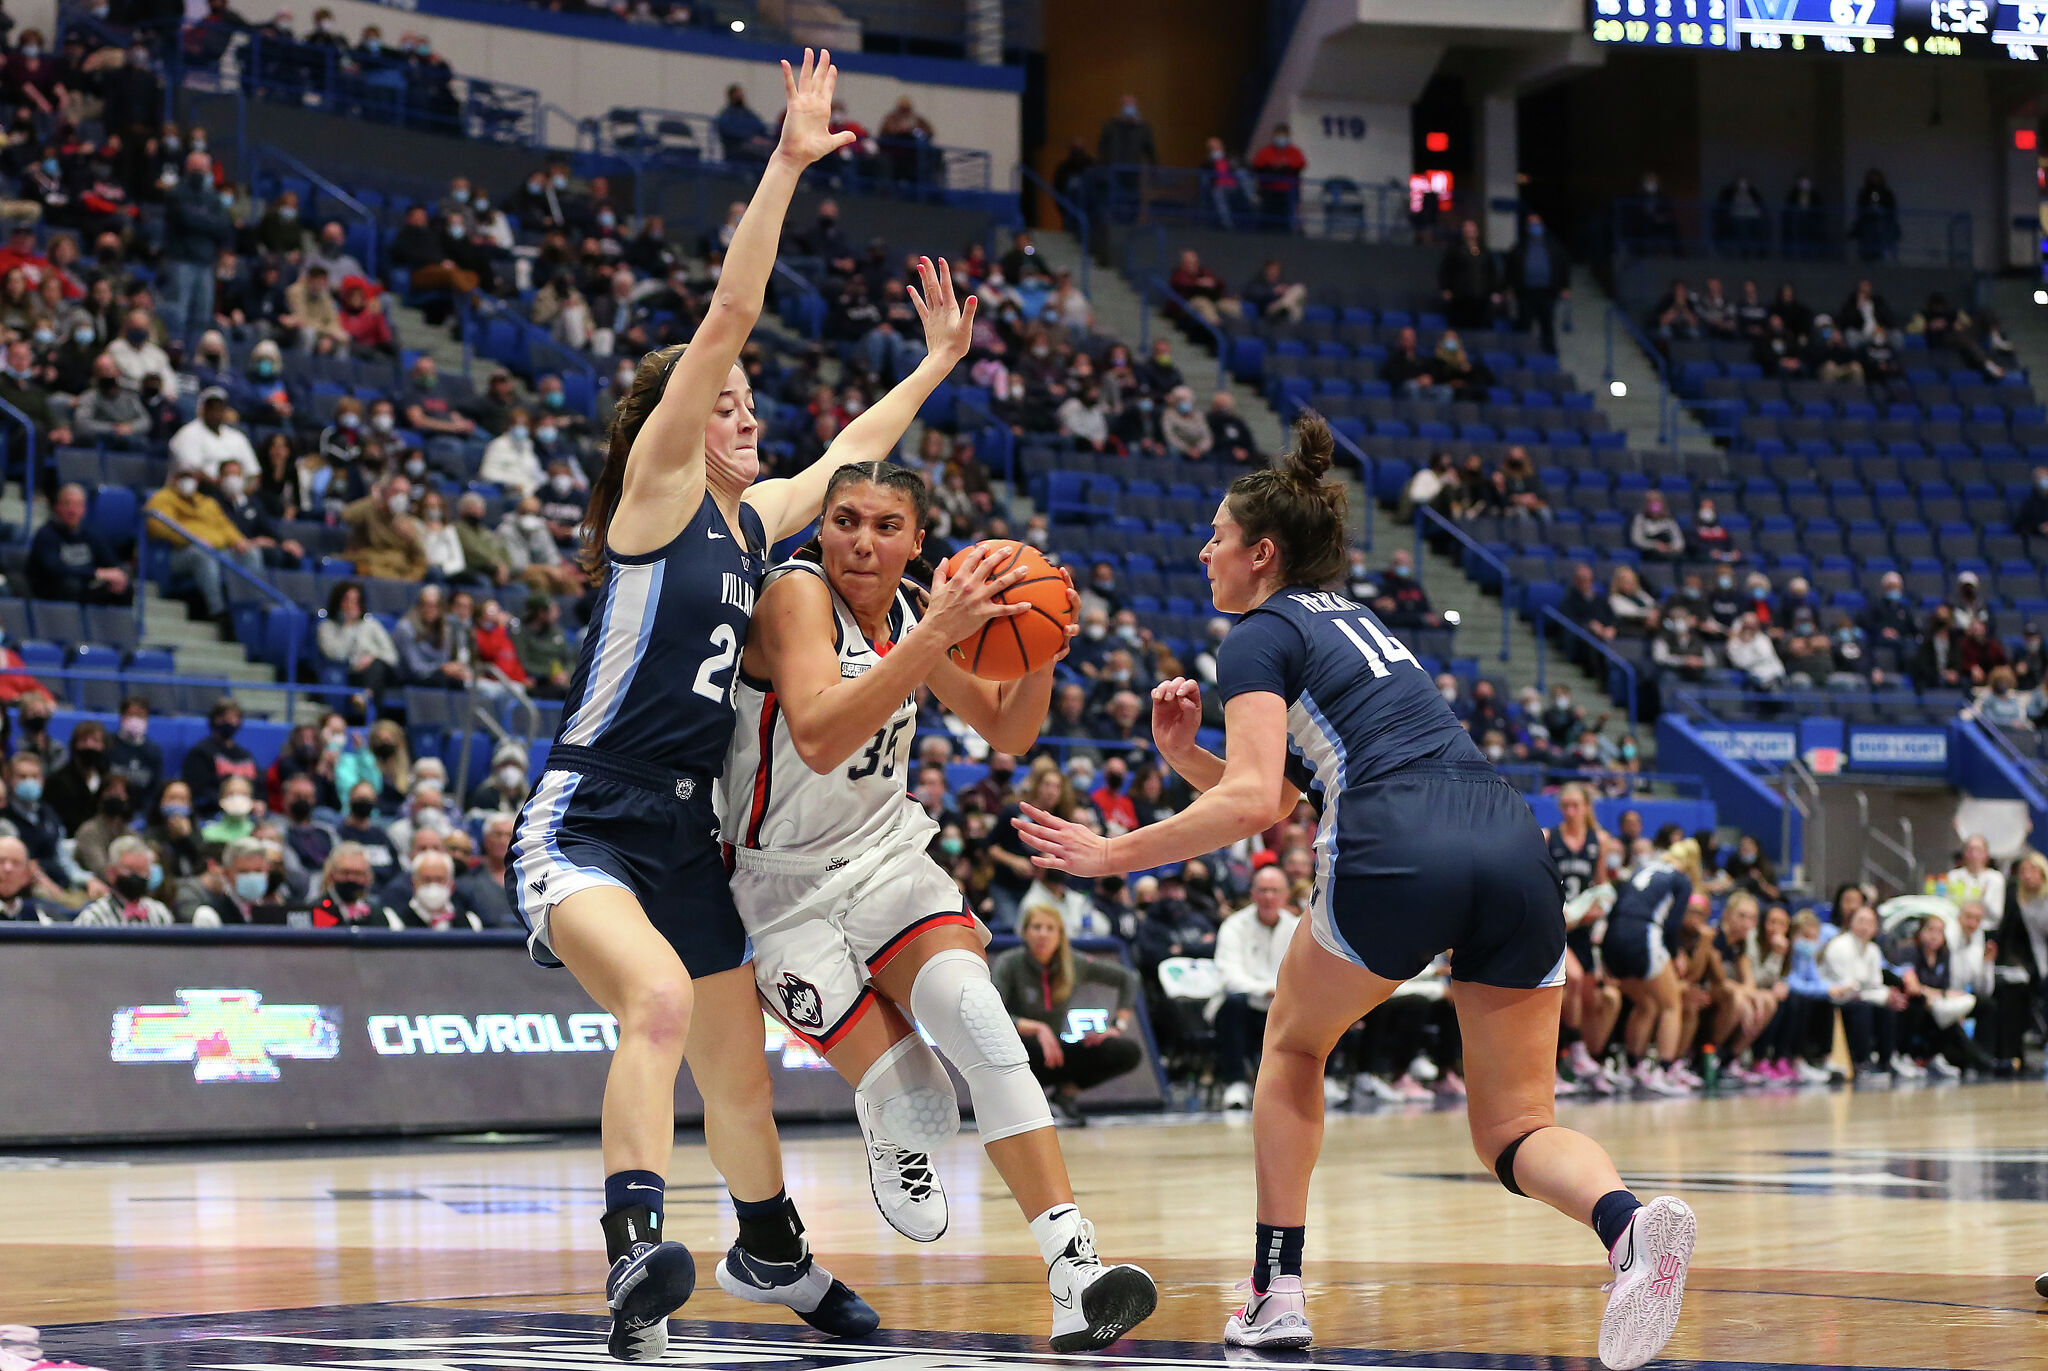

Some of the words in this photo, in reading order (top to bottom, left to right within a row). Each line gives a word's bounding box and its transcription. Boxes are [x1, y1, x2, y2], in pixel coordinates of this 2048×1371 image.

[1830, 0, 1876, 26] 67
[1930, 0, 1988, 34] 1:52
[1593, 19, 1625, 41] 20
[1624, 20, 1650, 42] 17
[1655, 21, 1673, 44] 2
[1678, 22, 1703, 45] 12
[1924, 36, 1961, 55] 4TH
[1322, 115, 1366, 139] 119
[1330, 616, 1425, 679] 14
[846, 716, 911, 781] 35
[368, 1013, 619, 1054] CHEVROLET
